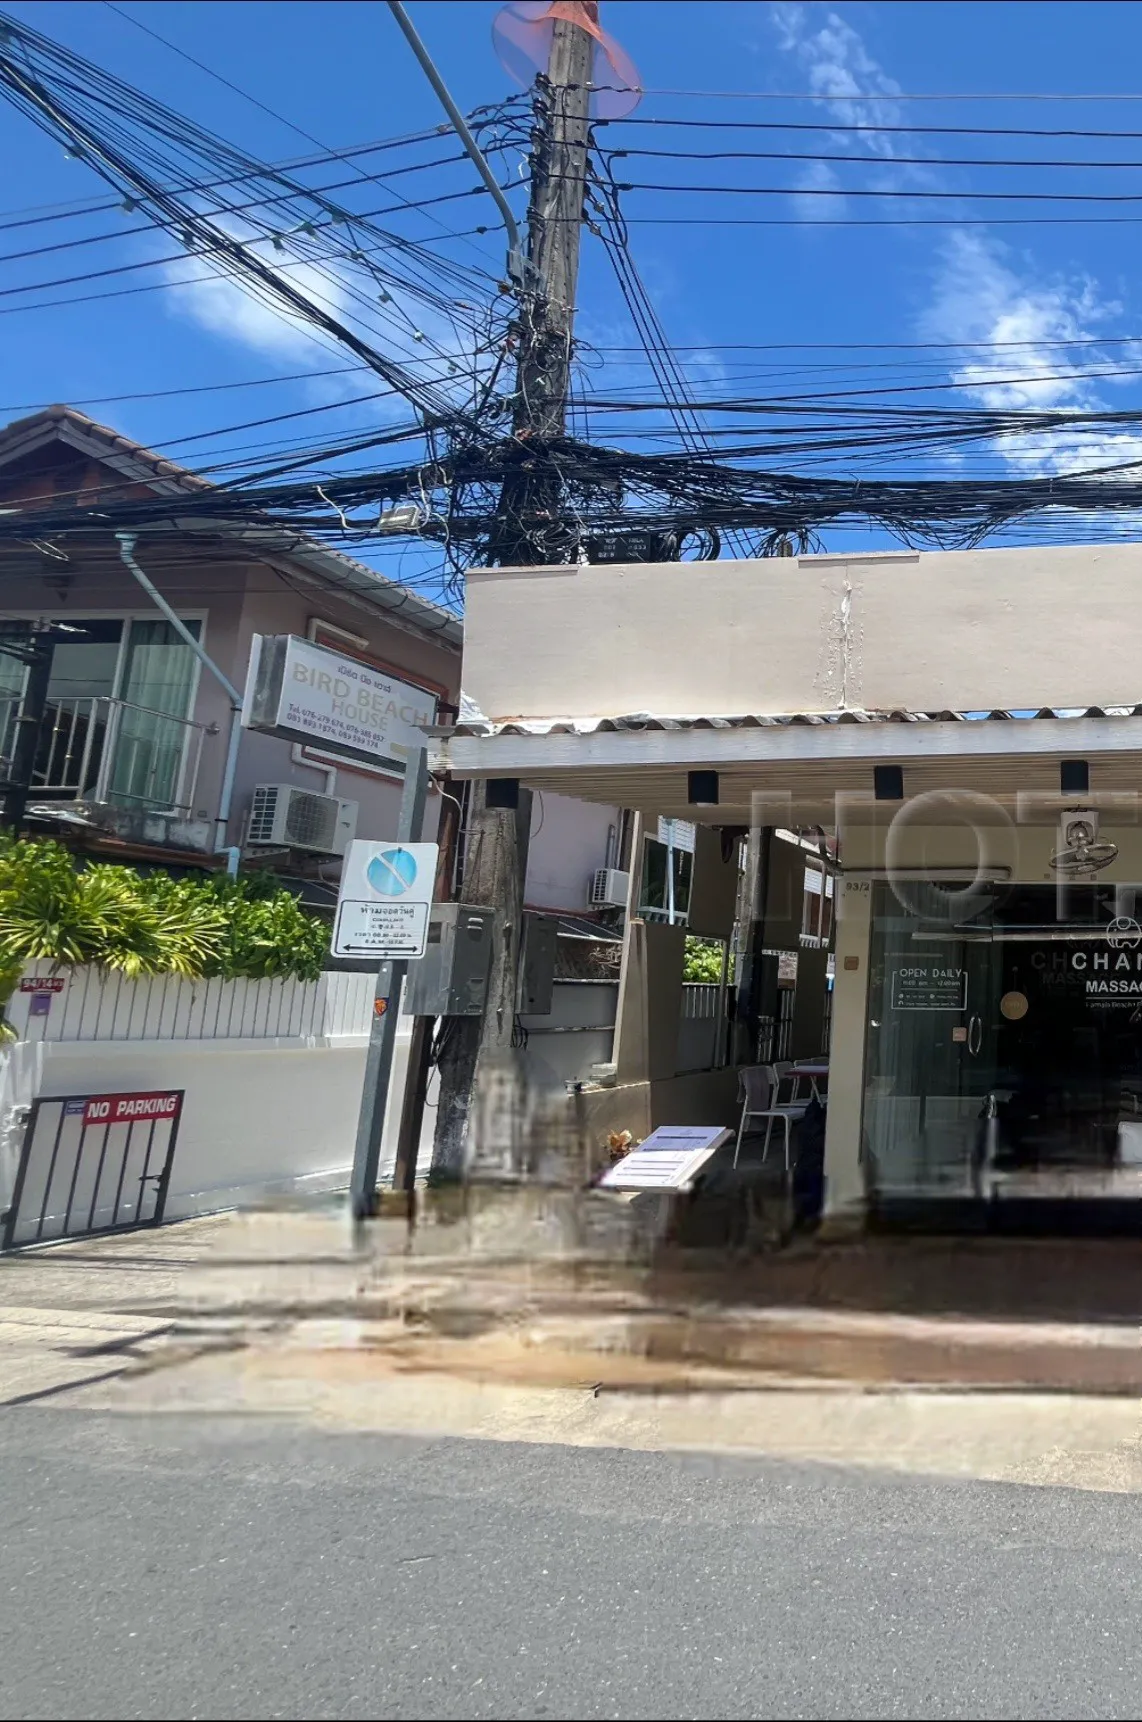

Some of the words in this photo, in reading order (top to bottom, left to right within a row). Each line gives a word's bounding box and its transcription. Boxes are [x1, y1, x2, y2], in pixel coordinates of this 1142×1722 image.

[293, 662, 350, 698] BIRD
[357, 688, 428, 726] BEACH
[332, 698, 389, 731] HOUSE
[845, 881, 870, 892] 93/2
[899, 968, 928, 977] OPEN
[932, 968, 962, 978] DAILY
[86, 1101, 111, 1118] NO
[116, 1096, 178, 1116] PARKING
